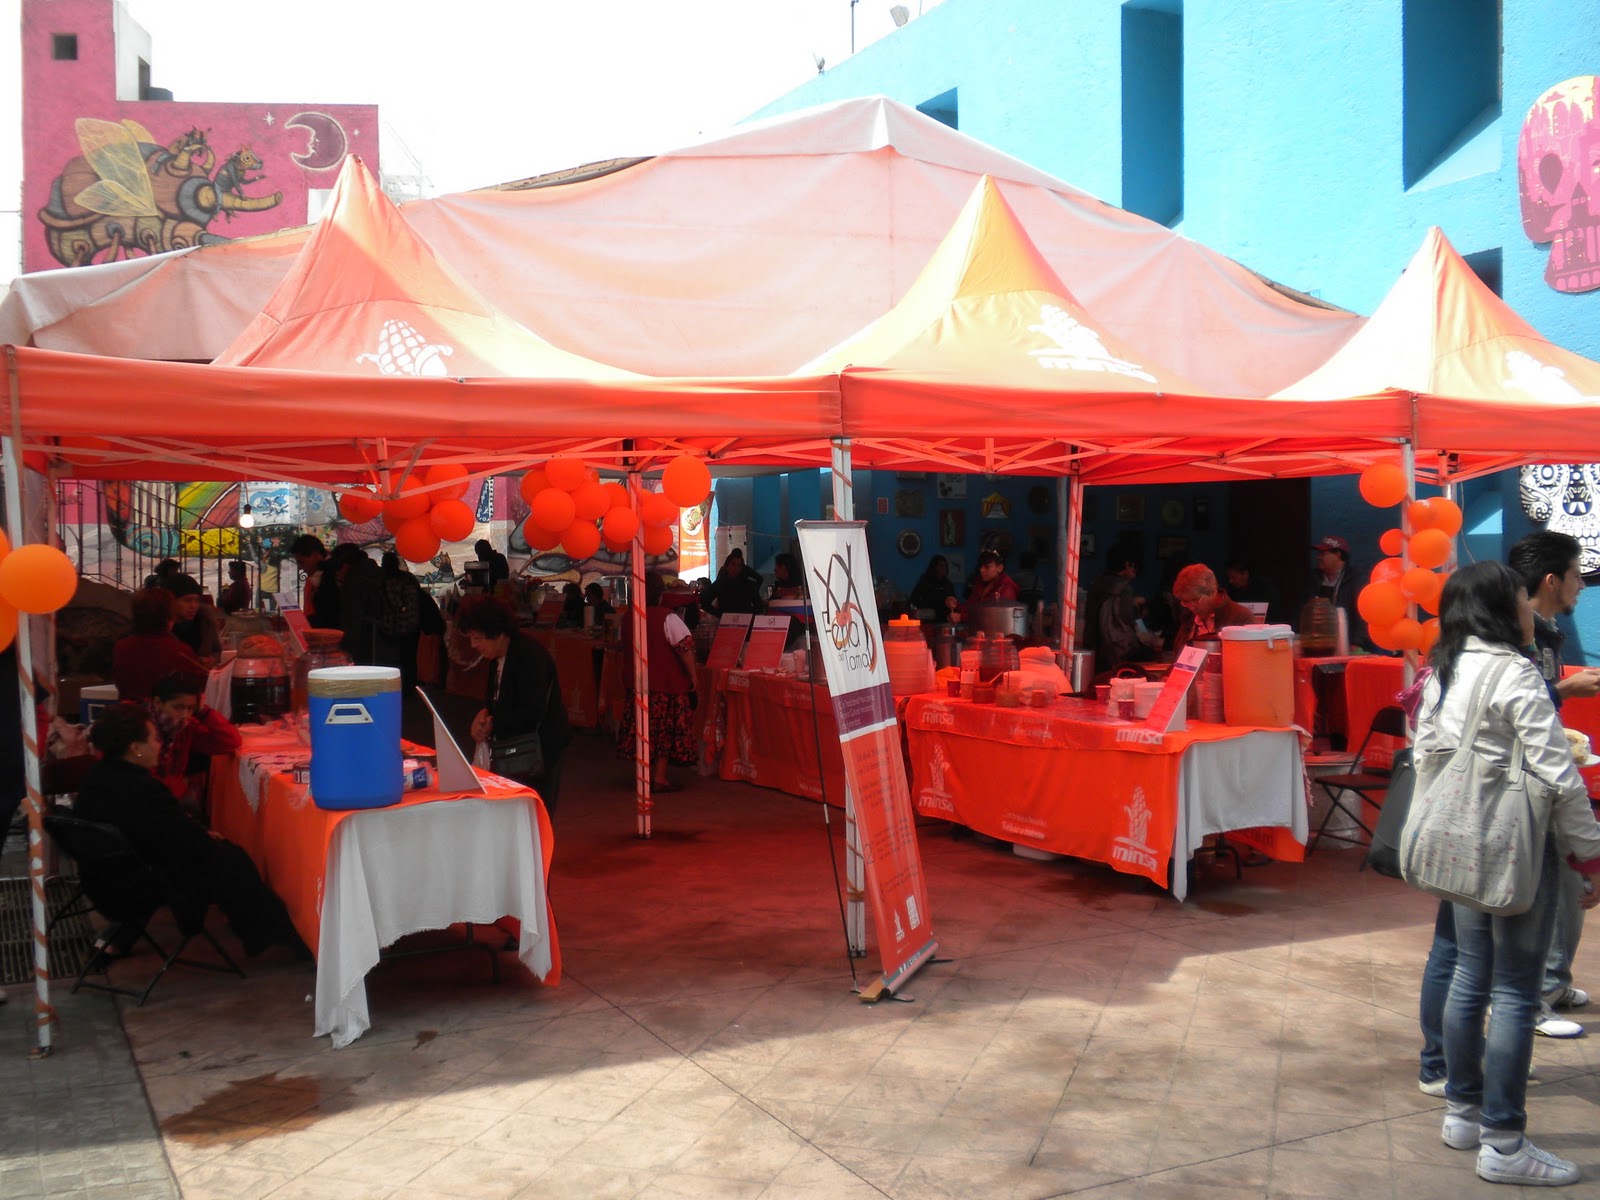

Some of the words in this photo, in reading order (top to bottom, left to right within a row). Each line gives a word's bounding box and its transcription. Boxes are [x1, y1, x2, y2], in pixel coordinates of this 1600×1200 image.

[922, 710, 955, 726] minsa
[1115, 729, 1162, 745] minsa
[918, 794, 954, 813] minsa
[1111, 844, 1158, 873] minsa
